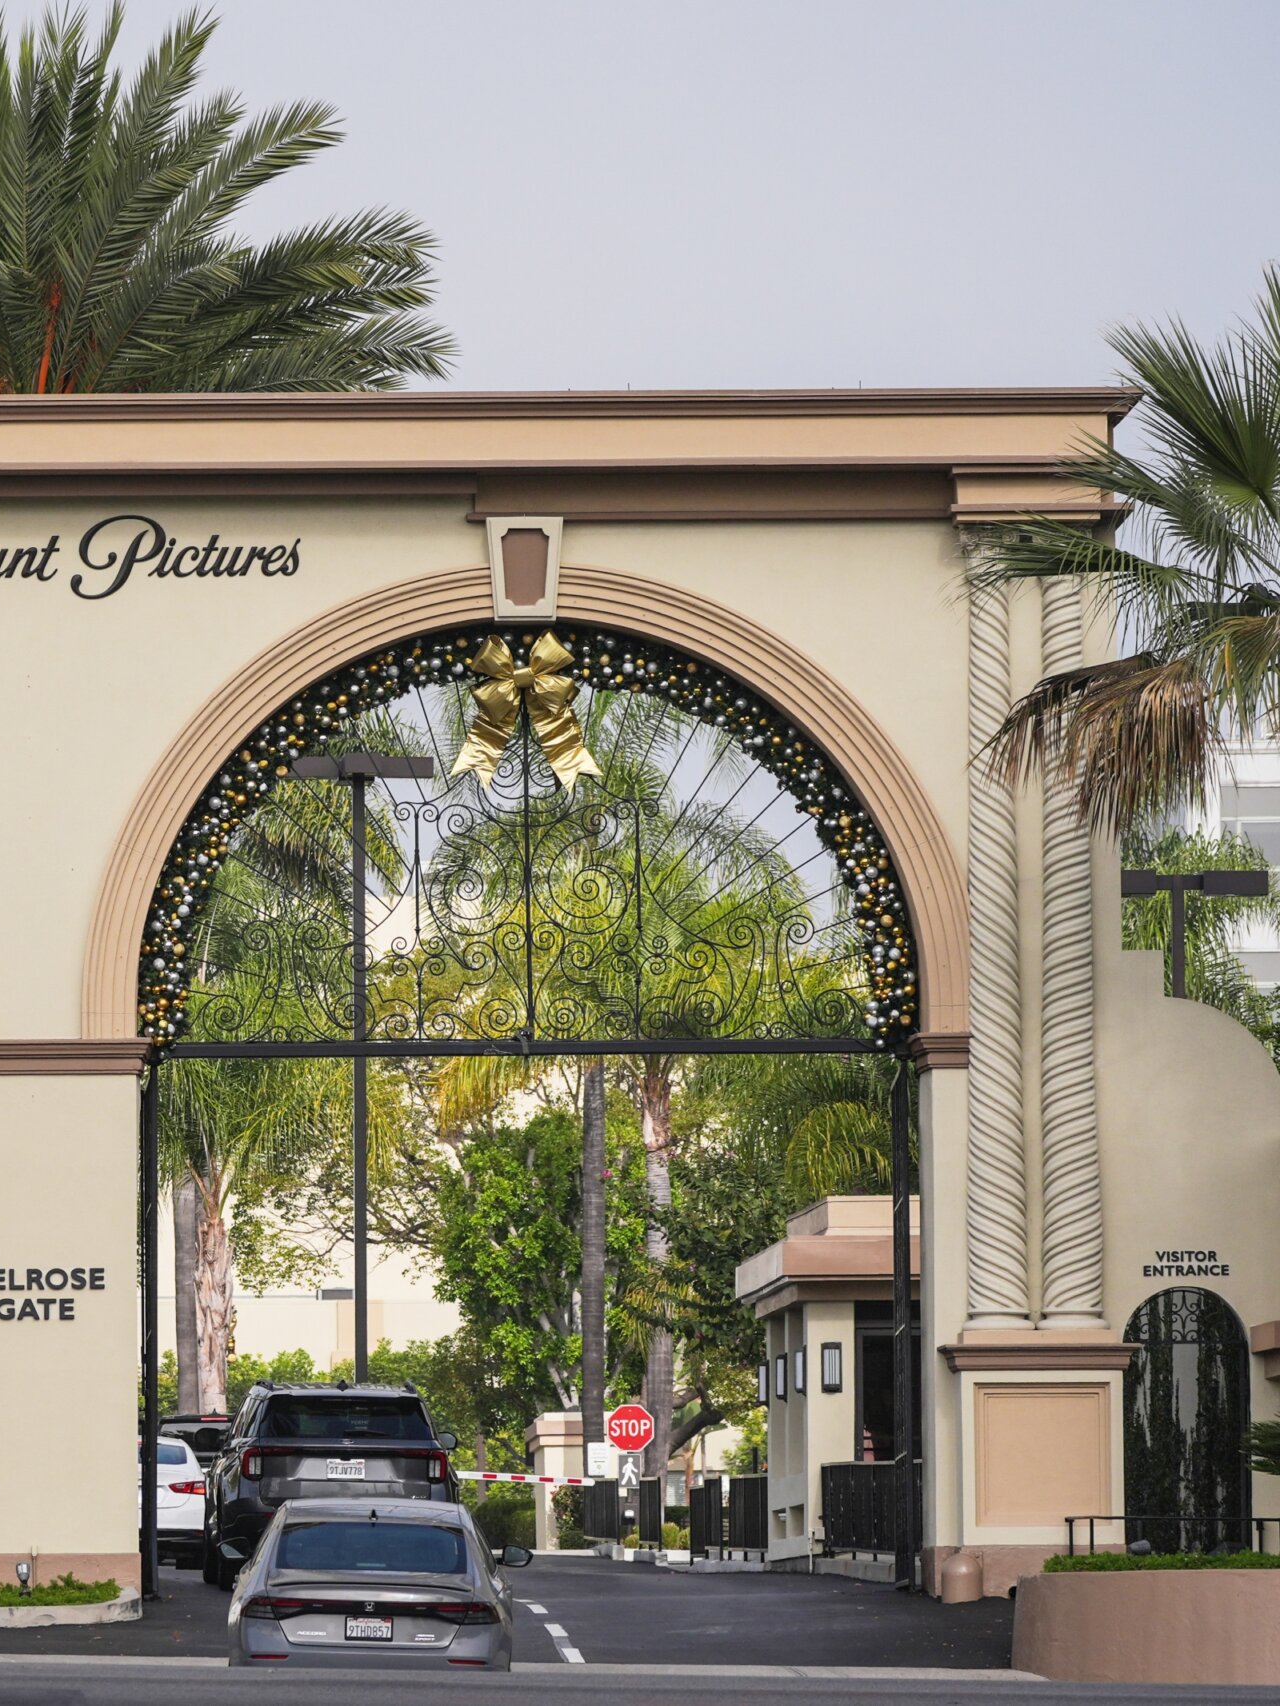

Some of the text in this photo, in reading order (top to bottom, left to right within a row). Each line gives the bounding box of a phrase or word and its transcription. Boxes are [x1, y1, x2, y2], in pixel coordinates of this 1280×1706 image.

[70, 514, 301, 600] Pictures
[1155, 1250, 1218, 1263] VISITOR
[1143, 1264, 1230, 1277] ENTRANCE
[610, 1419, 651, 1437] STOP
[348, 1624, 391, 1638] 9THD857
